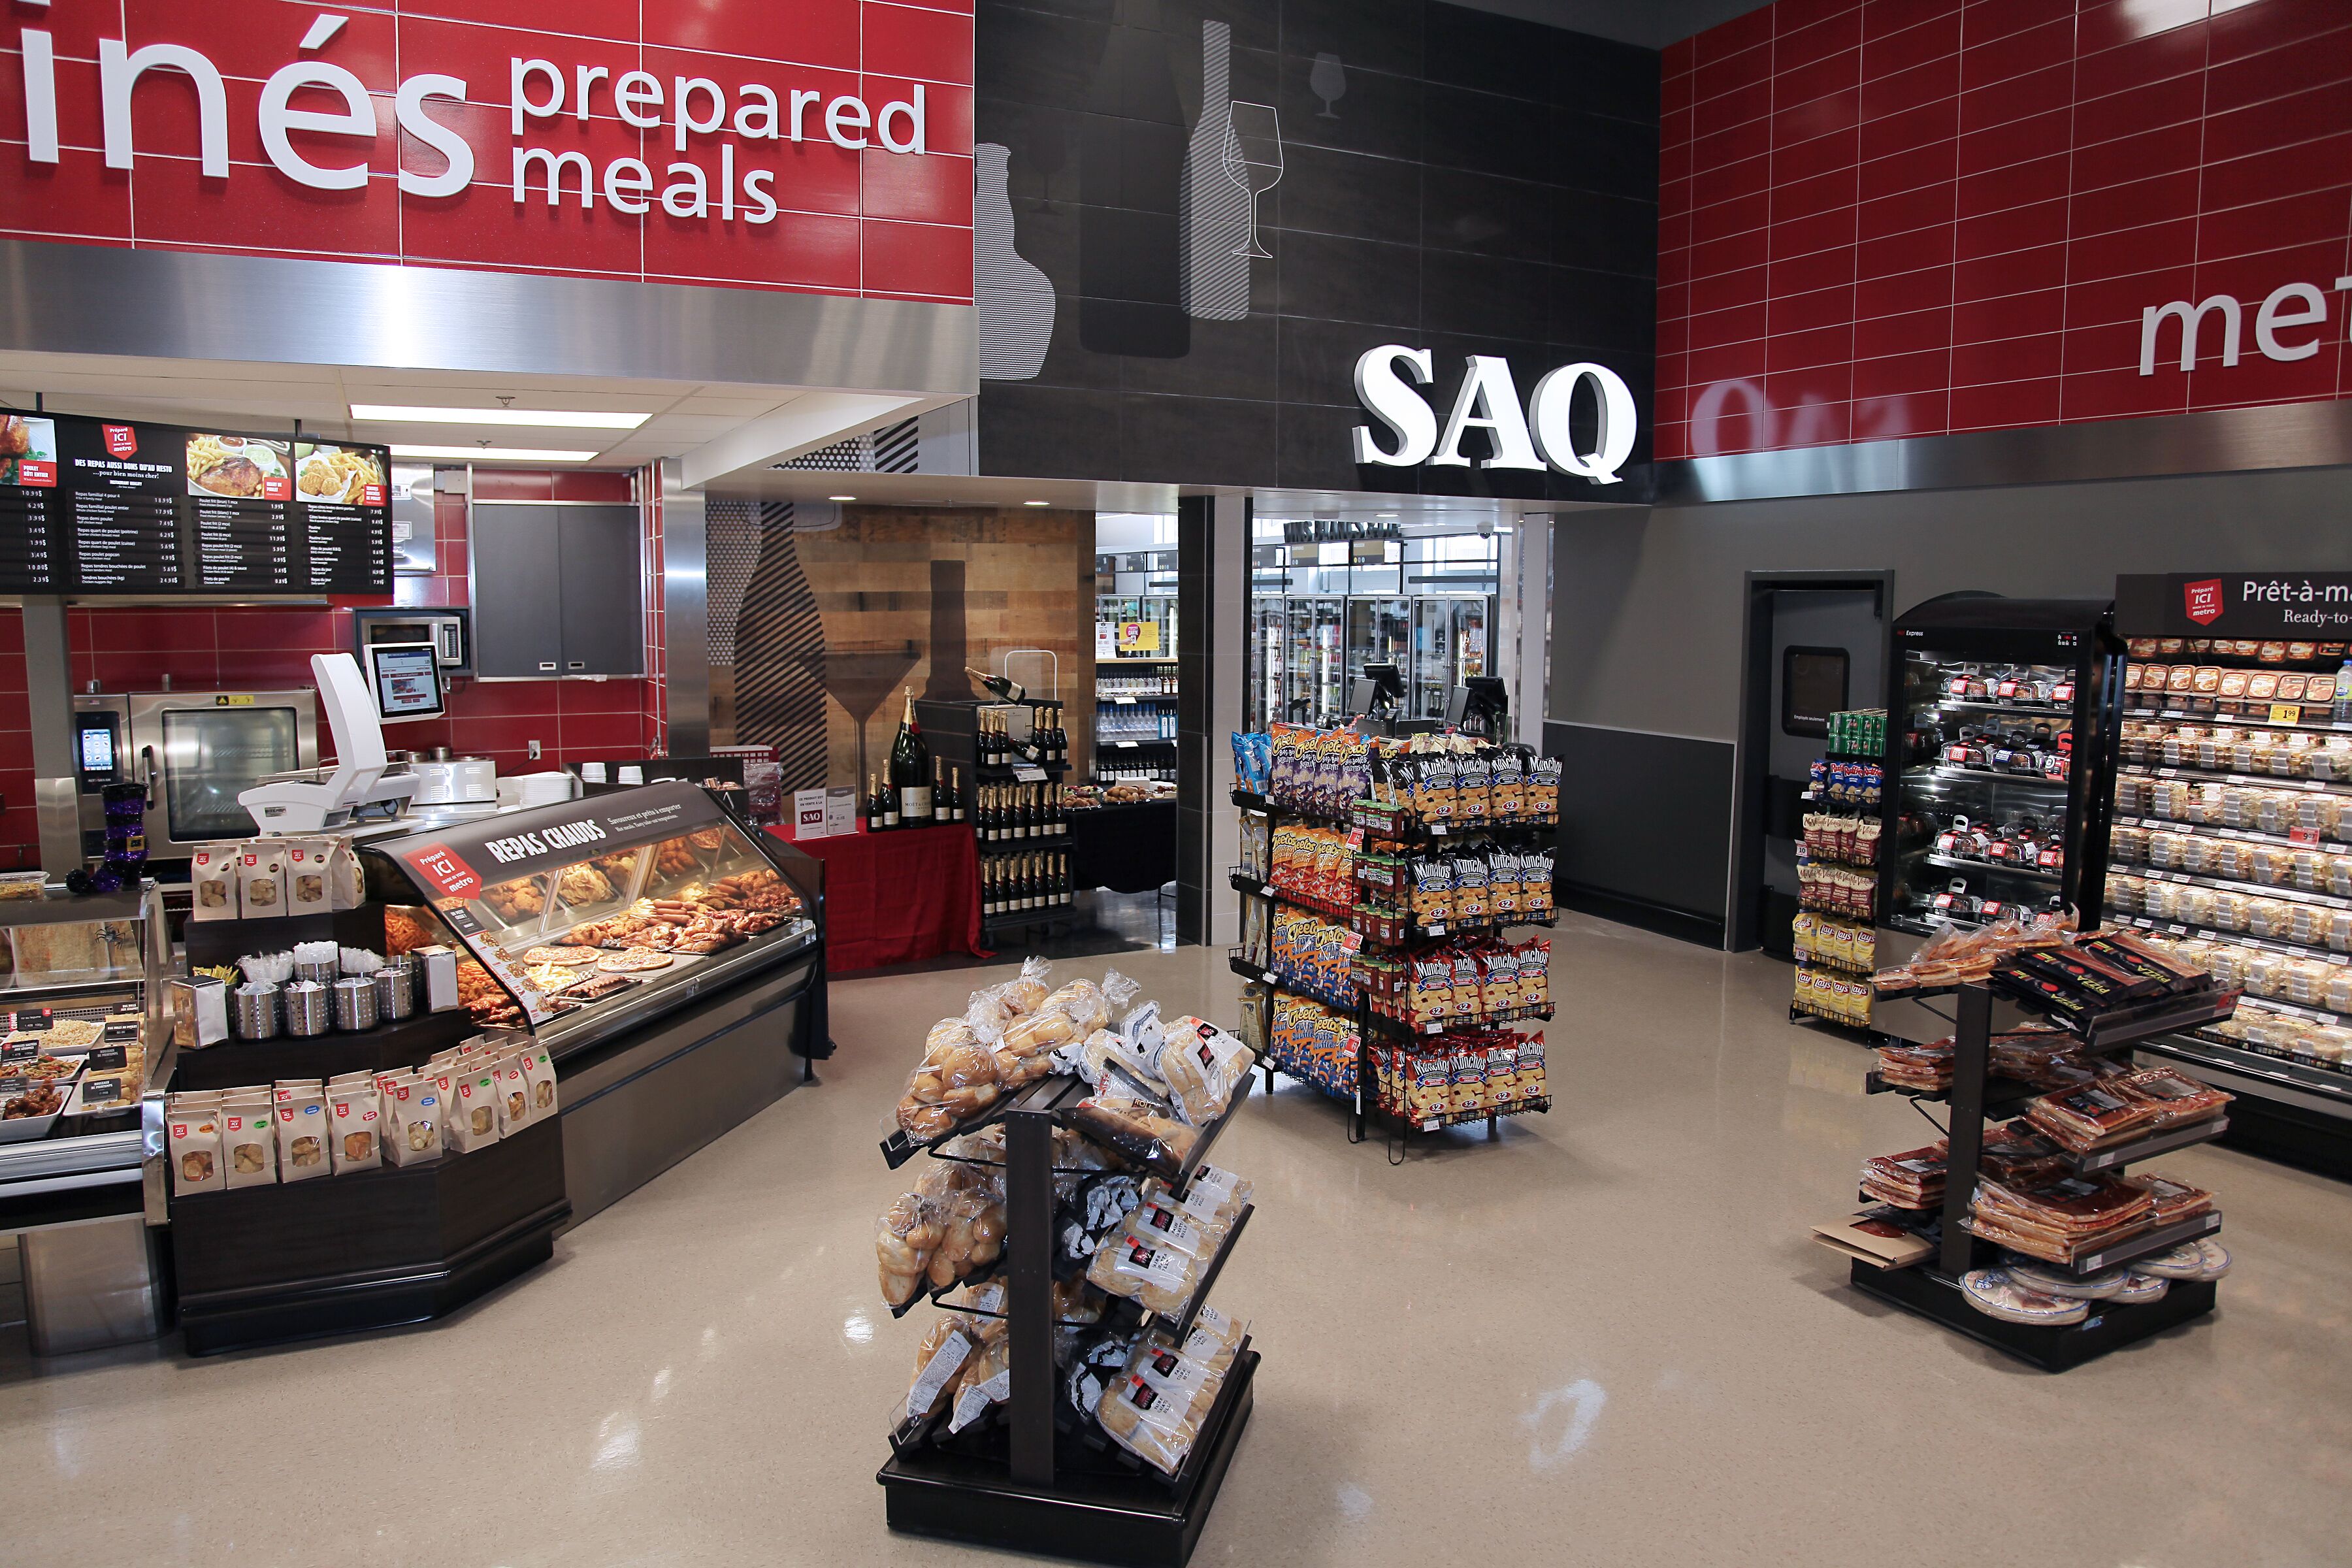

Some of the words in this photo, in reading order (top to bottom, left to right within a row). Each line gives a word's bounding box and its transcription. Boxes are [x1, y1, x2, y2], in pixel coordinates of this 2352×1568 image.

[16, 0, 474, 198] inés
[510, 56, 926, 155] prepared
[512, 143, 778, 225] meals
[2139, 274, 2352, 376] me
[1352, 344, 1637, 485] SAQ
[114, 433, 127, 442] ICI
[74, 459, 86, 467] DES
[87, 459, 105, 468] REPAS
[123, 462, 138, 470] BONS
[139, 463, 155, 472] QU'AU
[156, 465, 172, 473] RESTO
[2195, 594, 2212, 604] ICI
[2193, 608, 2215, 617] metro
[1456, 759, 1490, 777] Munchos
[1492, 755, 1522, 775] Munchos
[1469, 805, 1480, 813] $2
[1505, 802, 1516, 810] $2
[1537, 802, 1548, 811] $2
[607, 815, 638, 825] Savoureux
[641, 809, 655, 819] prêts
[658, 804, 681, 813] emporter
[803, 812, 821, 822] SAQ
[485, 833, 547, 865] REPAS
[542, 819, 607, 849] CHAUDS
[419, 850, 446, 865] Préparé
[432, 861, 456, 877] ICI
[1414, 862, 1451, 882] Munchos
[1453, 858, 1488, 875] Munchos
[448, 875, 474, 893] metro
[1467, 905, 1478, 913] $2
[1500, 900, 1511, 909] $2
[1432, 908, 1443, 917] $2
[1416, 961, 1451, 977] Munchos
[2137, 965, 2171, 983] PIZZA
[2077, 975, 2111, 994] PIZZA
[1498, 999, 1509, 1007] $2
[1527, 993, 1537, 1002] $2
[2051, 993, 2084, 1011] PIZZA
[1431, 1007, 1442, 1015] $2
[1459, 1003, 1469, 1011] $2
[1451, 1055, 1486, 1071] Munchos
[1498, 1092, 1509, 1100] $2
[1464, 1100, 1475, 1108] $2
